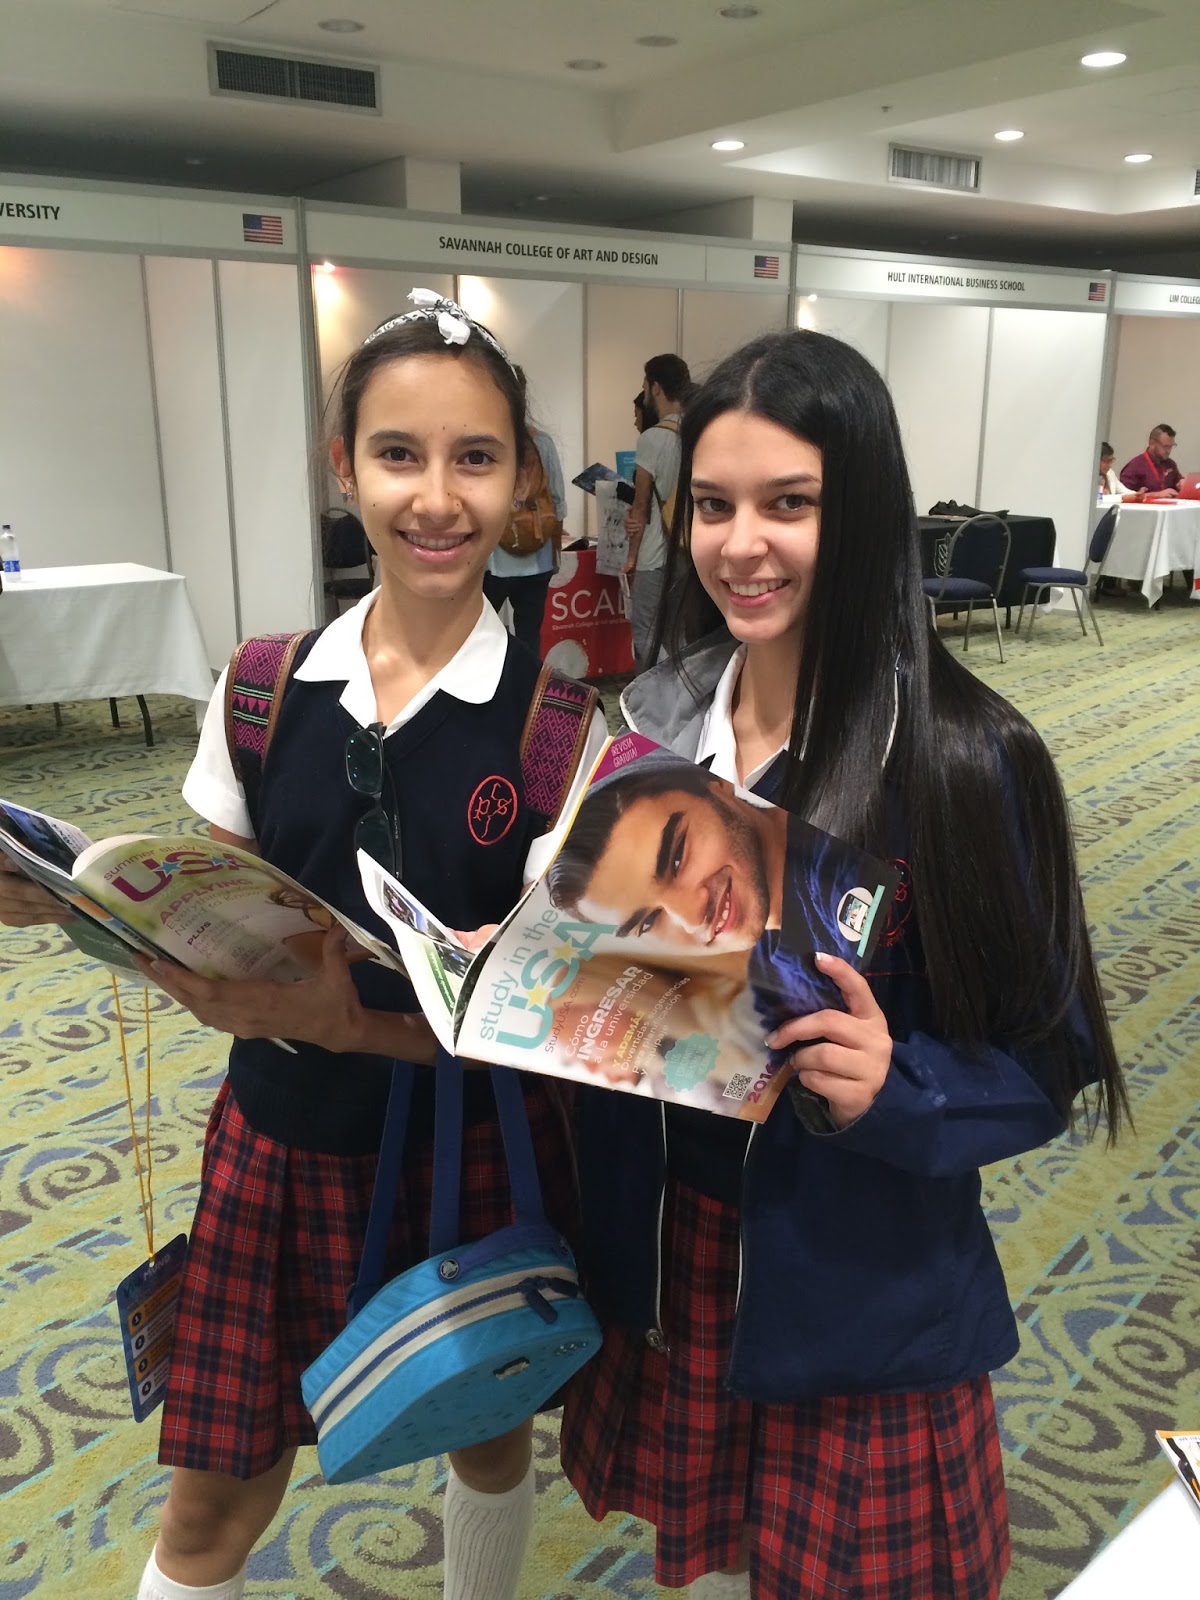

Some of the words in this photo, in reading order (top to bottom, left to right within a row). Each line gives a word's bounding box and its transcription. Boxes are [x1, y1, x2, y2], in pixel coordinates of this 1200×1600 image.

[439, 236, 502, 254] SAVANNAH
[505, 242, 553, 258] COLLEGE
[556, 246, 571, 259] OF
[573, 248, 593, 262] ART
[596, 250, 619, 263] AND
[621, 251, 659, 265] DESIGN
[887, 271, 907, 283] HULT
[908, 273, 964, 287] INTERNATIONAL
[966, 278, 998, 289] BUSINESS
[999, 280, 1026, 291] SCHOOL
[1180, 295, 1200, 304] COLLEG
[103, 849, 155, 881] summer
[159, 878, 254, 925] APPLYING
[186, 921, 212, 946] PLUS
[479, 970, 519, 1041] study
[503, 945, 532, 965] in
[522, 909, 559, 942] the
[495, 921, 620, 1050] USA
[544, 976, 586, 1053] StudyUSA.com
[565, 1014, 589, 1058] Cómo
[577, 966, 643, 1061] INGRESAR
[594, 1055, 603, 1064] a
[599, 1040, 609, 1055] la
[605, 972, 654, 1037] universidad
[616, 1010, 645, 1059] ADEMÁS
[620, 1021, 650, 1071] Divertidas
[647, 977, 691, 1020] sugerencias
